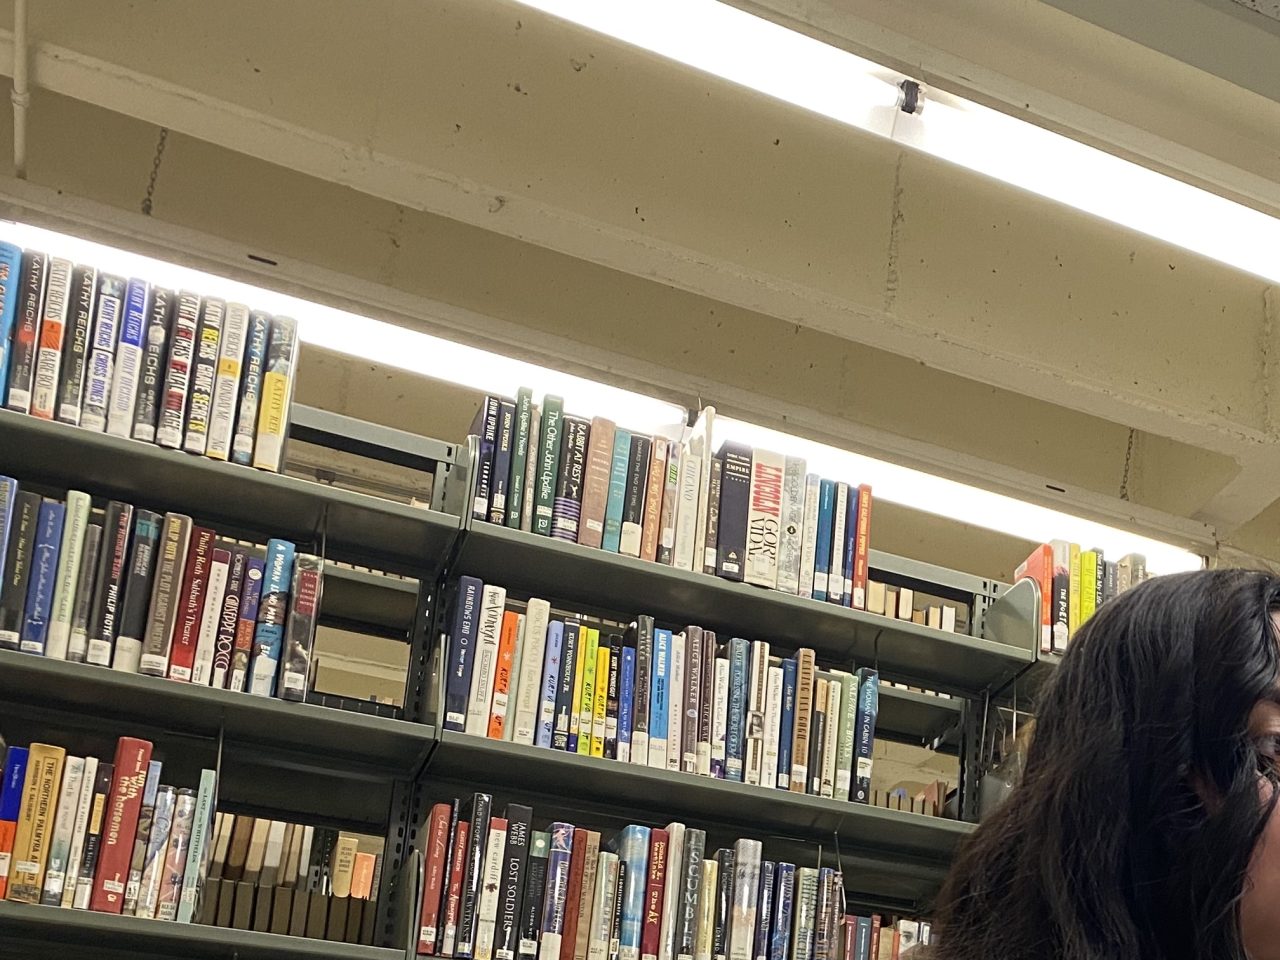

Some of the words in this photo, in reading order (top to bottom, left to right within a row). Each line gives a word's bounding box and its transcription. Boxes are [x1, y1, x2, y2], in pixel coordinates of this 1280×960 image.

[30, 255, 40, 289] KATHY
[80, 271, 91, 308] KATHY
[24, 293, 35, 332] REICHS
[102, 297, 117, 319] KATHY
[73, 311, 87, 353] REICHS
[98, 321, 114, 347] REICHS
[199, 328, 219, 360] REICHS
[252, 316, 265, 353] KATHY
[95, 352, 107, 376] CROSS
[194, 363, 214, 392] GRAVE
[246, 356, 259, 401] REICHS
[89, 378, 104, 403] BONES
[188, 393, 210, 432] SECRETS
[488, 398, 497, 415] JOHN
[548, 411, 558, 426] The
[485, 416, 496, 440] UPDIKE
[545, 427, 556, 449] Other
[576, 424, 586, 450] RABBIT
[544, 450, 555, 470] John
[575, 451, 582, 463] AT
[540, 471, 553, 499] Updike
[571, 465, 581, 483] REST
[684, 460, 697, 500] CHICANO
[753, 463, 782, 517] LINCOLN
[119, 512, 128, 525] The
[169, 518, 182, 541] PHILIP
[114, 528, 126, 556] Human
[166, 541, 178, 559] ROTH
[198, 532, 211, 555] Philip
[112, 558, 122, 579] Stain
[164, 560, 174, 573] THE
[193, 556, 206, 575] Roth
[271, 554, 284, 580] WOMAN
[161, 575, 173, 592] PLOT
[187, 578, 201, 613] Sabbath's
[269, 584, 279, 593] IS
[1095, 580, 1102, 590] My
[106, 584, 118, 612] PHILIP
[156, 593, 169, 621] AGAINST
[268, 594, 278, 606] NO
[464, 585, 475, 620] RAINBOWS
[264, 607, 276, 627] MAN
[1059, 601, 1067, 622] POET
[102, 613, 114, 636] ROTH
[181, 614, 196, 645] Theater
[462, 621, 471, 634] END
[150, 622, 164, 652] AMERICA
[658, 633, 667, 650] ALICE
[691, 637, 699, 664] ALICE
[657, 651, 665, 676] WALKER
[802, 654, 812, 692] LEAVING
[499, 667, 507, 686] KURT
[547, 673, 555, 694] KURT
[689, 667, 697, 704] WALKER
[866, 675, 874, 687] THE
[864, 688, 873, 715] WOMAN
[797, 716, 807, 740] GOGH
[864, 715, 871, 723] IN
[862, 724, 870, 744] CABIN
[862, 746, 869, 754] 10
[45, 762, 54, 776] THE
[137, 770, 147, 787] run
[118, 776, 130, 793] the
[126, 776, 139, 798] with
[38, 779, 52, 817] NORTHERN
[107, 795, 128, 845] horsemen
[32, 819, 45, 853] PALMYRA
[494, 832, 502, 849] new
[510, 823, 519, 845] WEBB
[518, 822, 527, 847] JAMES
[490, 852, 501, 881] cardiff
[508, 858, 520, 882] LOST
[502, 884, 516, 931] SOLDIERS
[647, 910, 659, 924] AX
